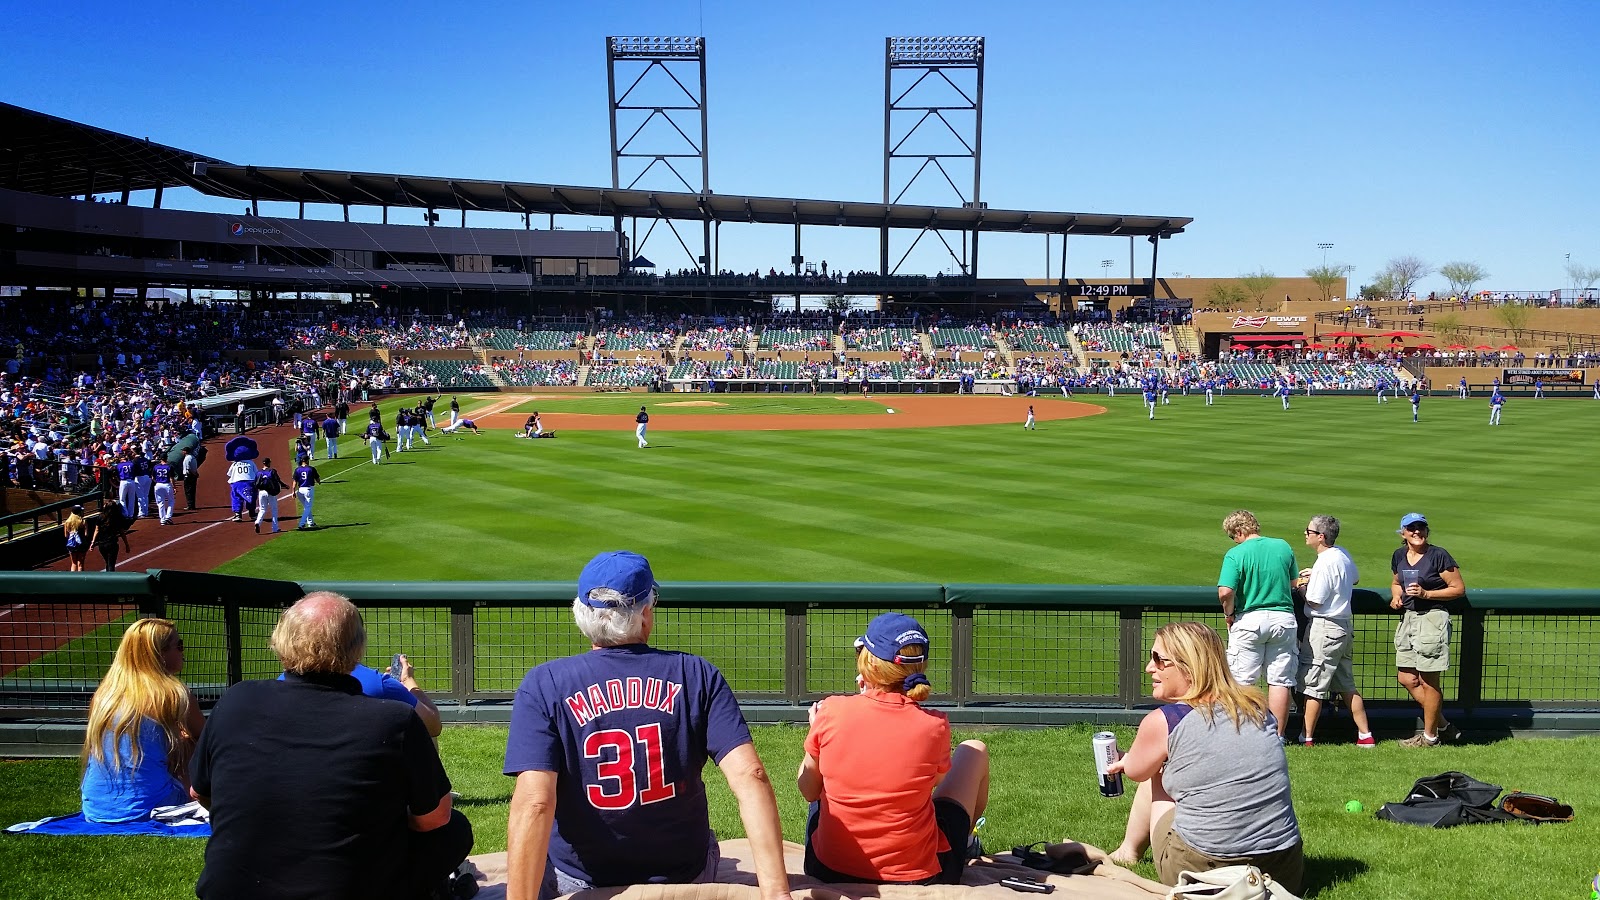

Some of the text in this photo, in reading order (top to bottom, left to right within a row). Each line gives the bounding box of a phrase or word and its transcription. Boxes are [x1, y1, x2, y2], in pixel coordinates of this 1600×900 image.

[1080, 285, 1128, 296] 12:49 PM
[122, 464, 132, 474] 31
[140, 461, 149, 470] 55
[237, 466, 249, 474] 00
[156, 468, 168, 478] 52
[301, 471, 307, 480] 9
[565, 677, 682, 727] MADDUX
[584, 722, 675, 810] 31
